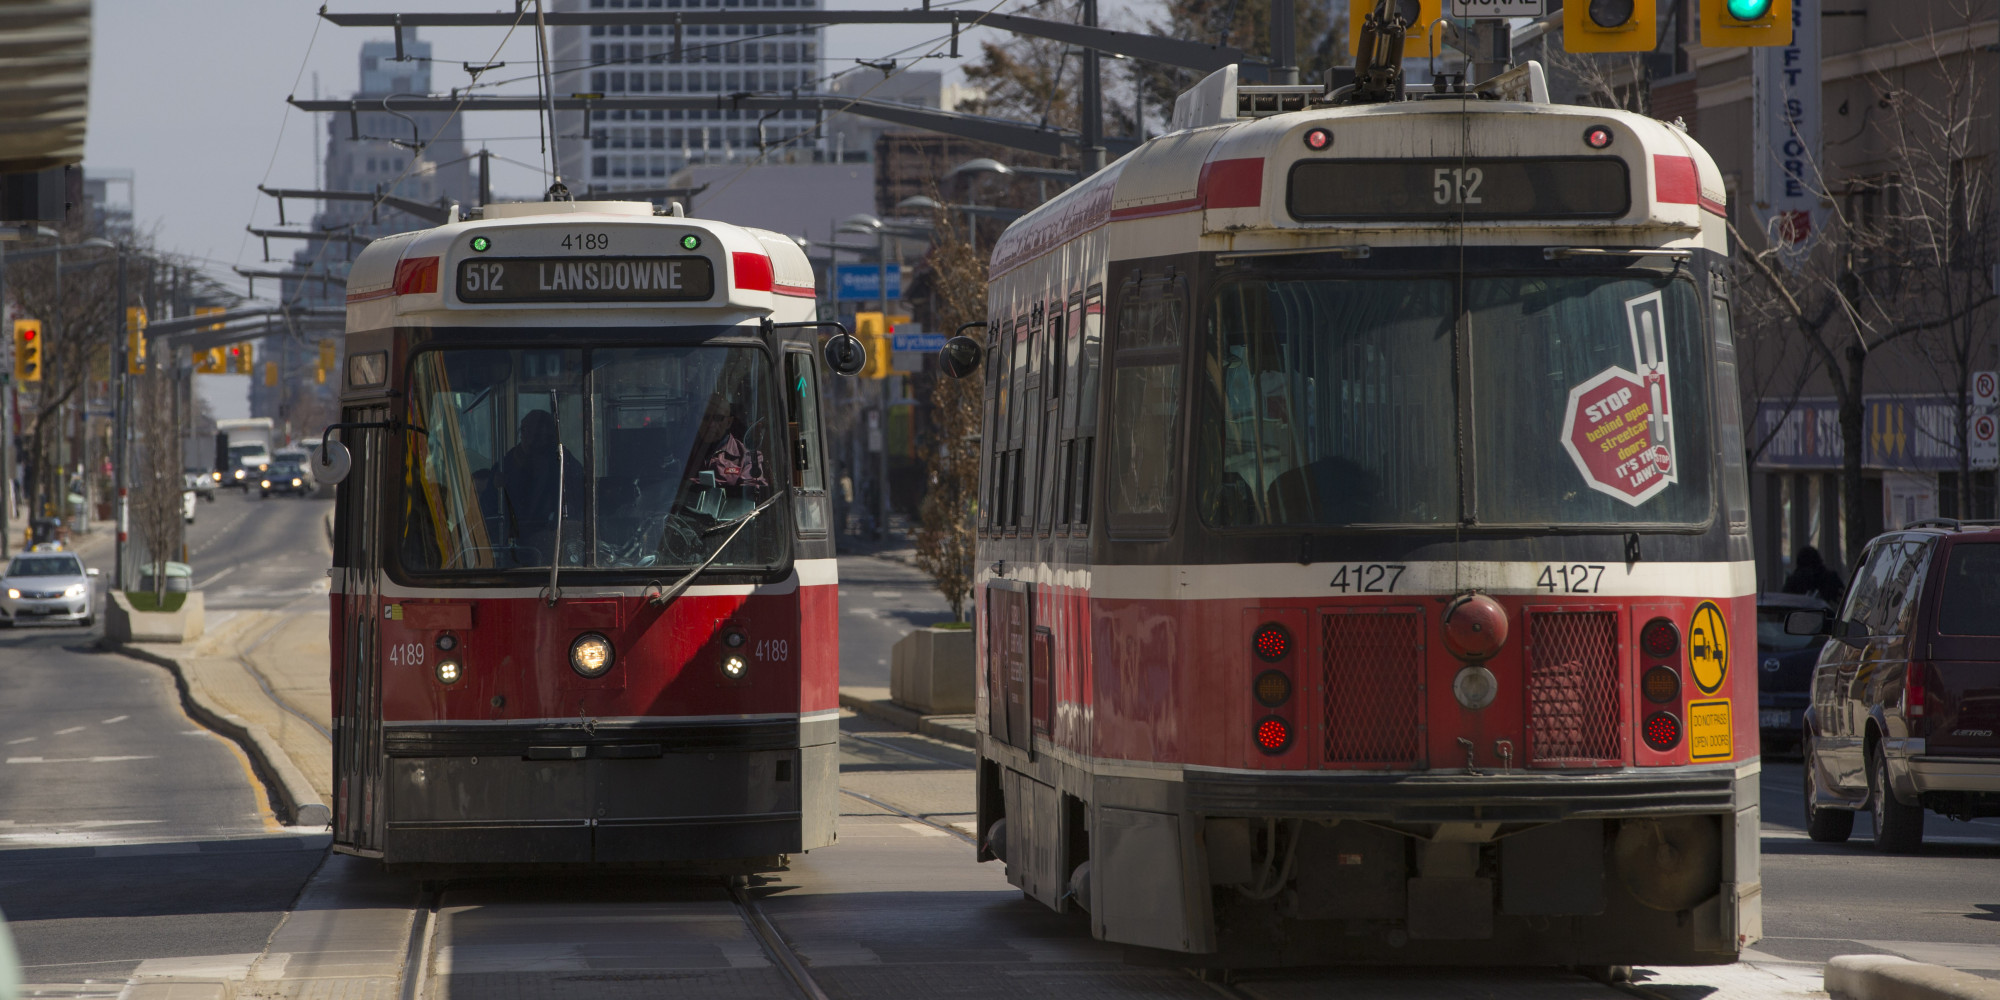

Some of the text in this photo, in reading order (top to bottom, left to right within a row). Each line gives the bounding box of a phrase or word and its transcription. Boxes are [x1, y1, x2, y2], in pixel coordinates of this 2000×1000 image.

[1783, 99, 1804, 197] STORE
[1433, 167, 1484, 205] 512
[561, 233, 609, 250] 4189
[466, 262, 683, 292] 512 LANSDOWNE
[1585, 387, 1632, 423] STOP
[1586, 402, 1649, 443] behind open
[1600, 419, 1648, 453] streetcar
[1615, 445, 1657, 479] IT'S THE
[1617, 437, 1648, 461] doors
[1654, 454, 1670, 465] STOP
[1629, 463, 1657, 488] LAW!
[1330, 564, 1406, 593] 4127
[1536, 564, 1606, 593] 4127
[389, 643, 425, 666] 4189
[755, 639, 788, 662] 4189
[1693, 713, 1728, 727] DO NOT PASS
[1694, 734, 1728, 748] OPEN DOORS
